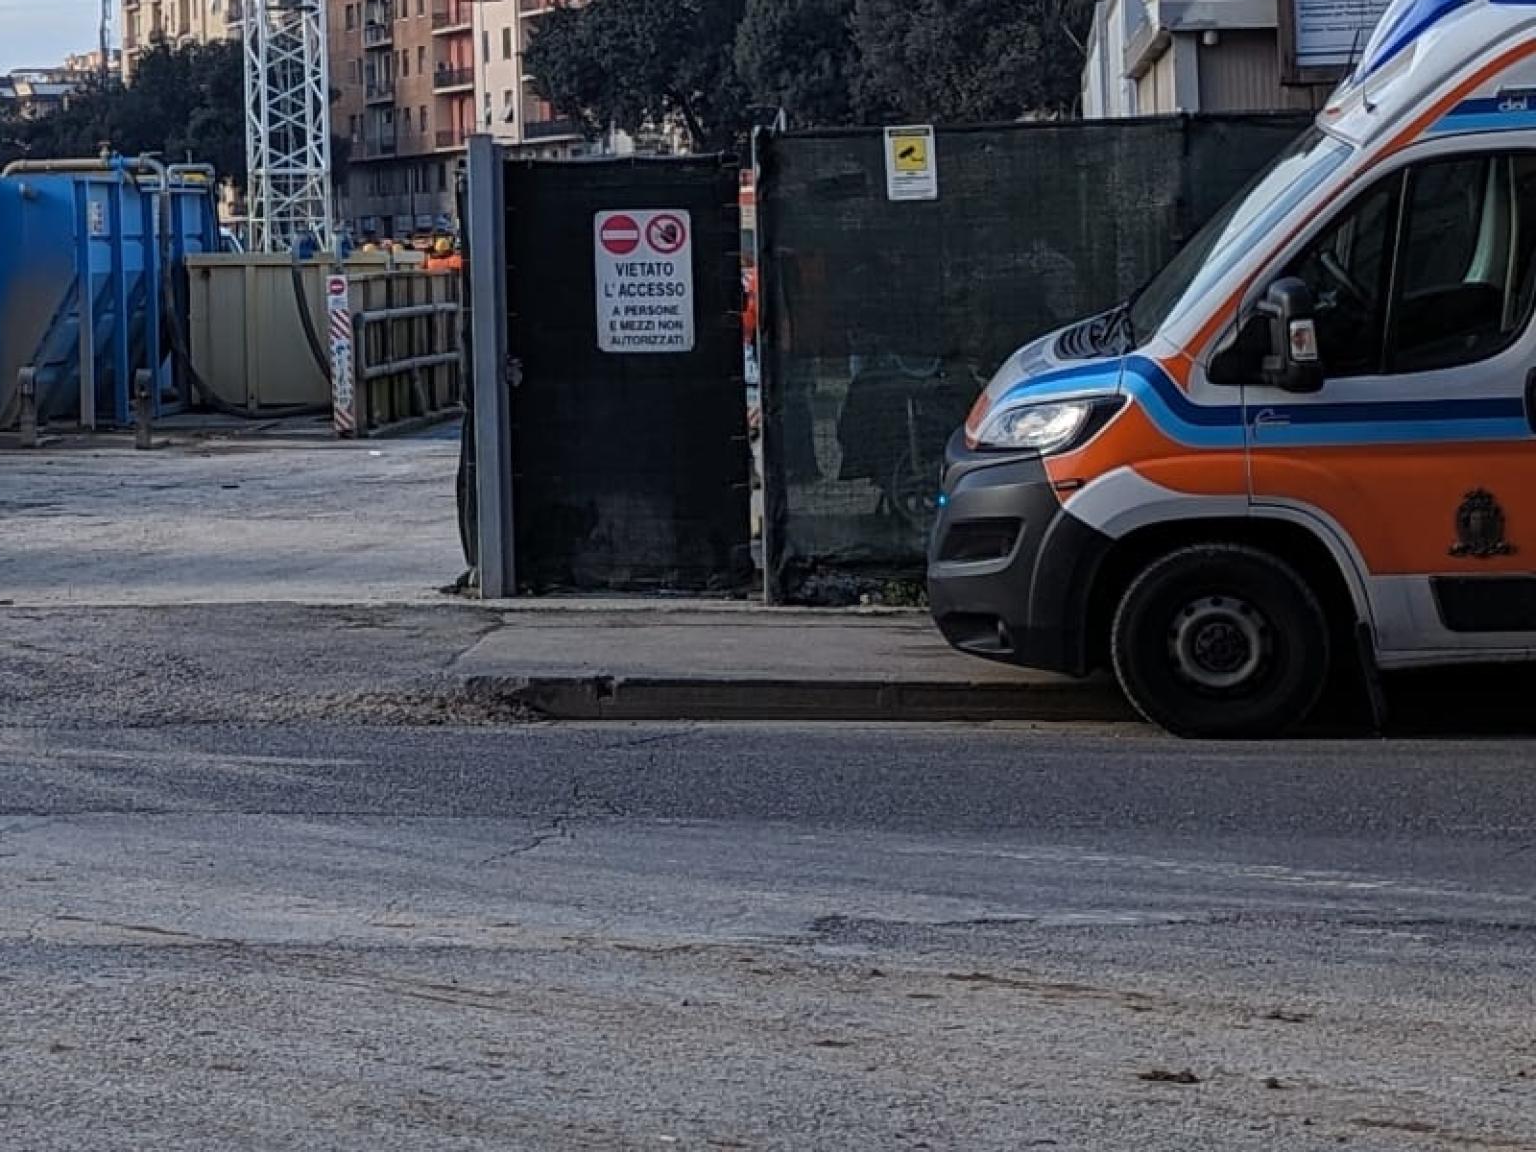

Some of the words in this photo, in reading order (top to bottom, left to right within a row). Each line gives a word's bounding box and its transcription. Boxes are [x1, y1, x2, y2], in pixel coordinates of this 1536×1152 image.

[615, 262, 675, 277] VIETATO
[612, 305, 621, 316] A
[624, 304, 681, 316] PERSONE
[609, 320, 617, 332] E
[620, 320, 654, 331] MEZZI
[658, 320, 683, 331] NON
[611, 335, 684, 345] AUTORIZZATI
